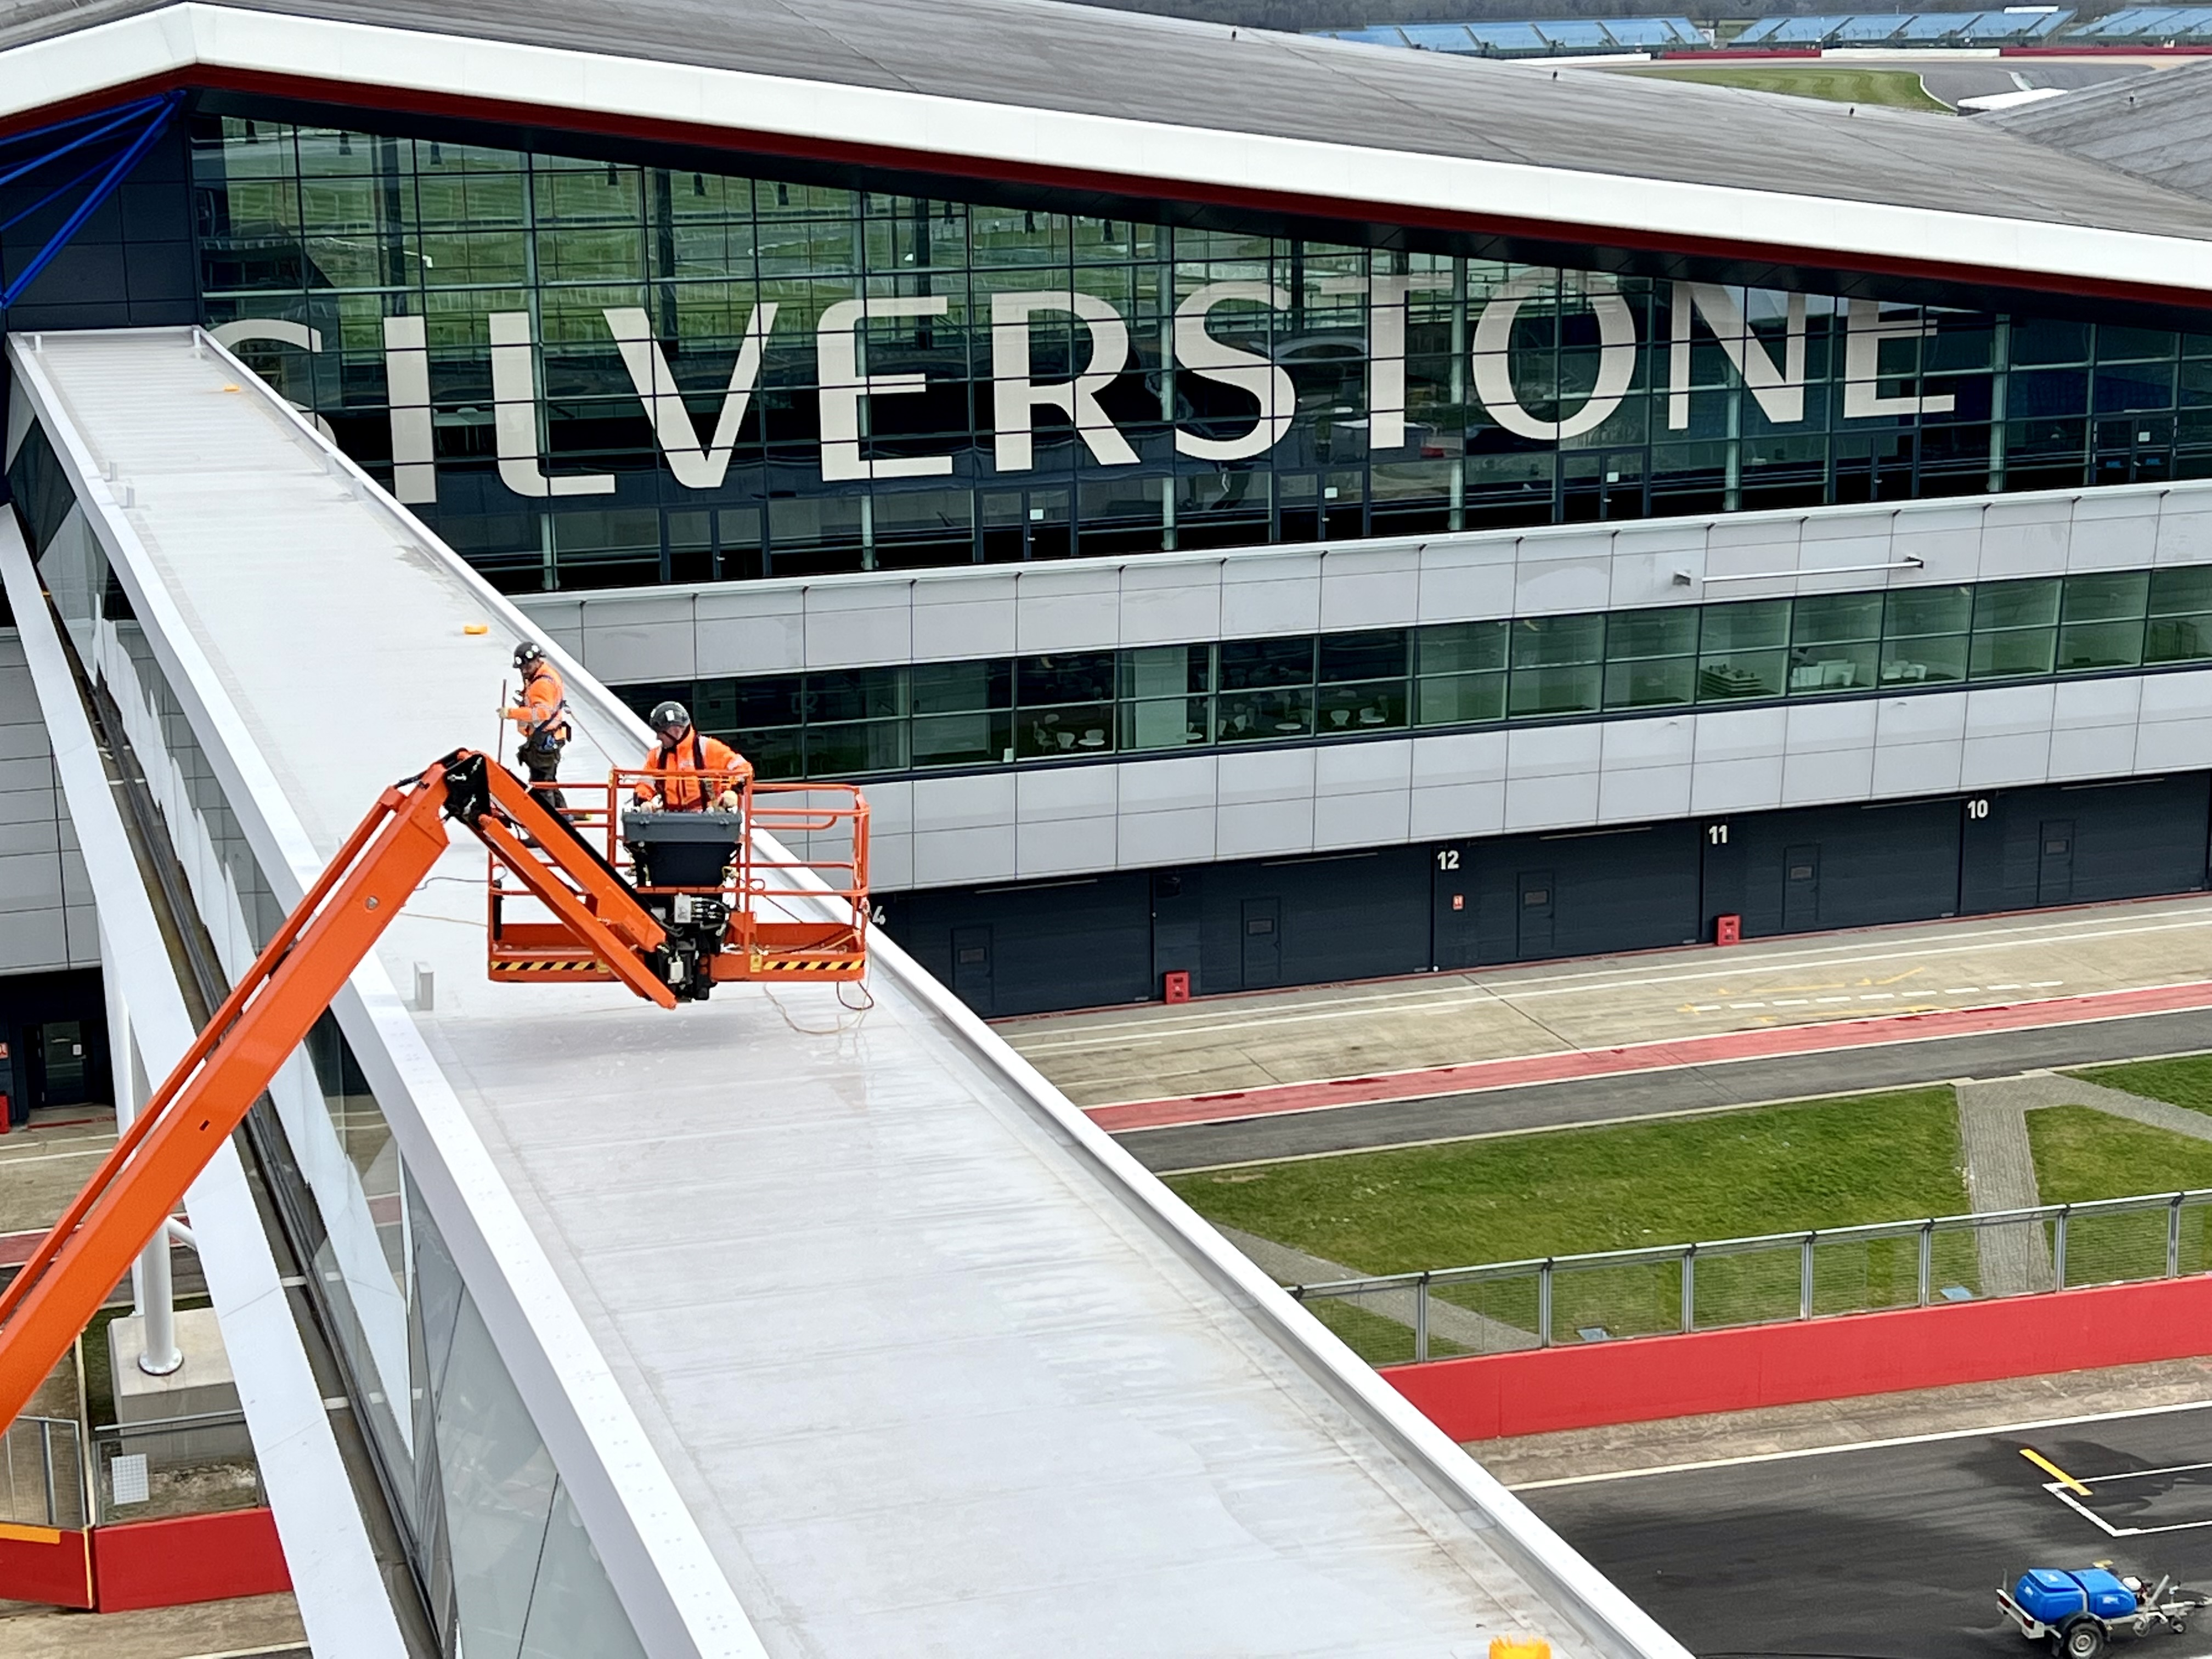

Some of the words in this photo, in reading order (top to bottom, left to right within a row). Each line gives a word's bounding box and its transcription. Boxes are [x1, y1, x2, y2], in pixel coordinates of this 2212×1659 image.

[1967, 799, 1988, 819] 10
[1709, 825, 1728, 844] 11
[1437, 850, 1459, 870] 12
